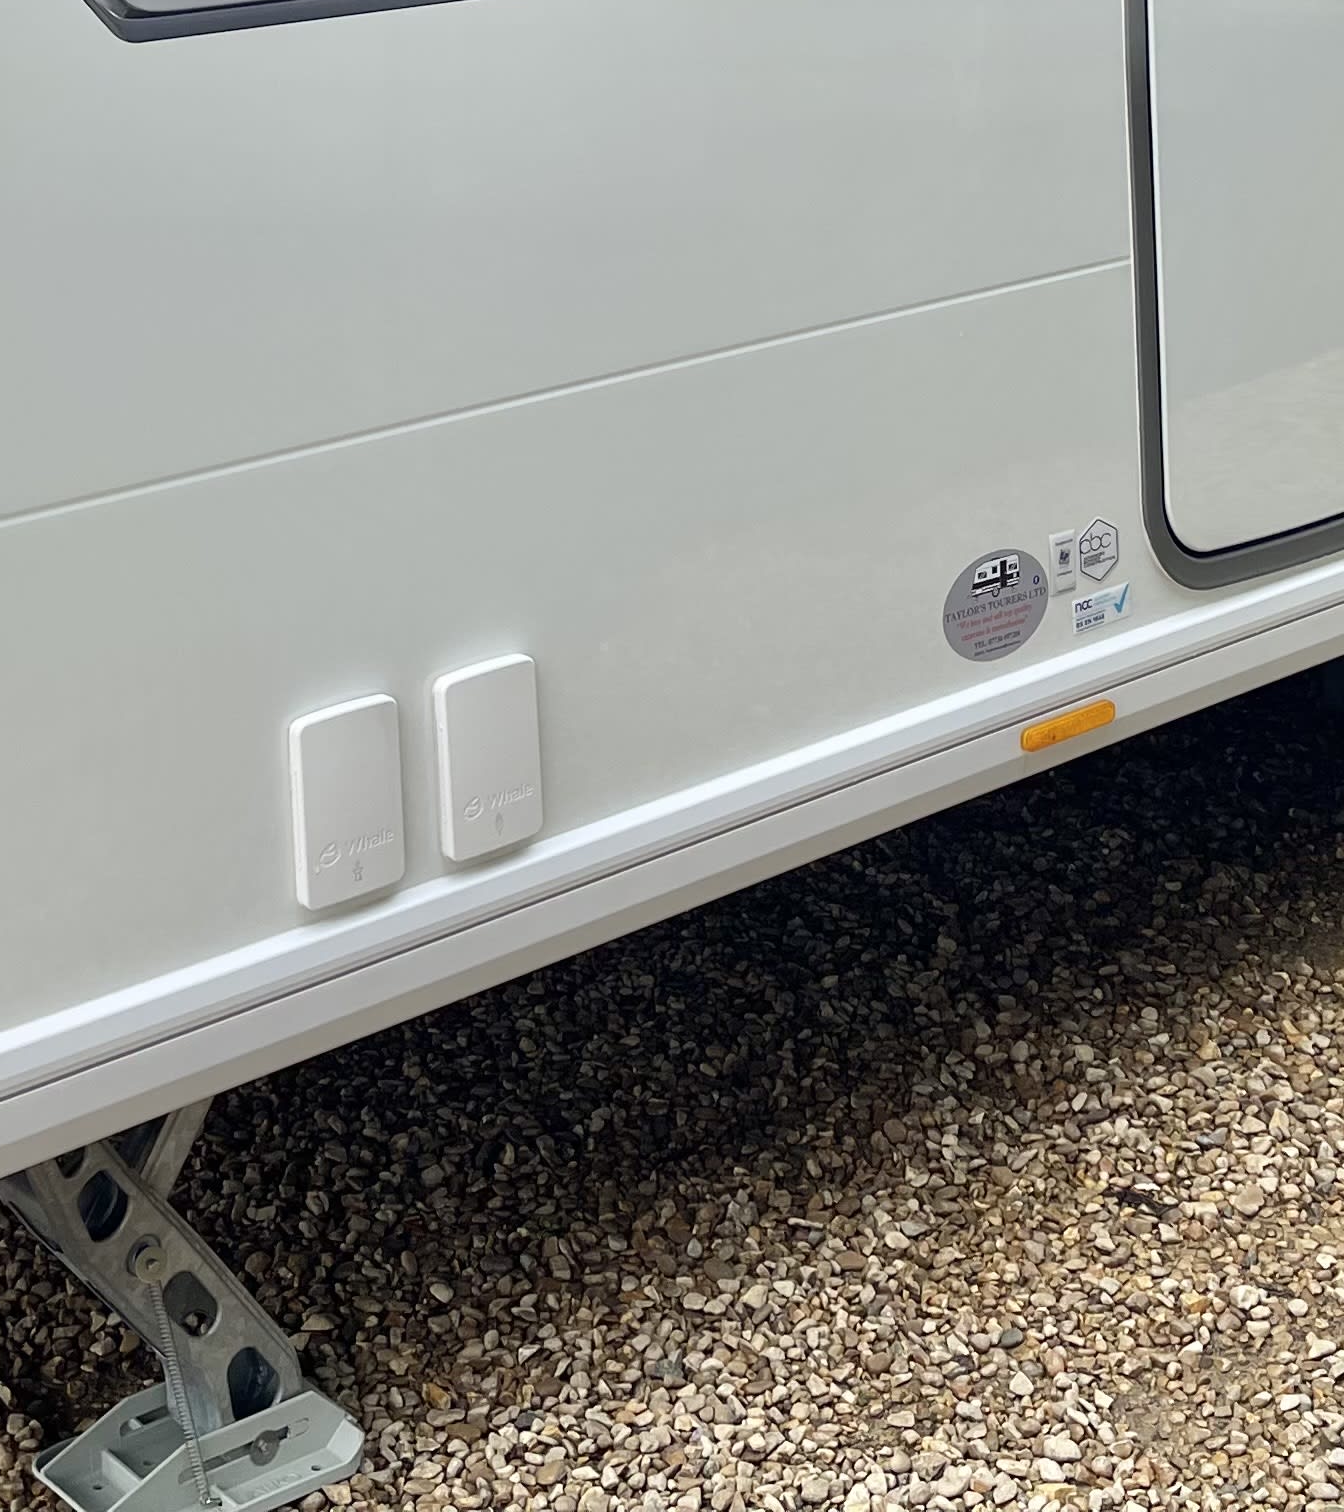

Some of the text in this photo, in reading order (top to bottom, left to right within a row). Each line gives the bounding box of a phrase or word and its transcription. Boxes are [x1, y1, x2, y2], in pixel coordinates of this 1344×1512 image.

[988, 591, 1028, 611] TOURERS
[1028, 586, 1047, 601] LTD
[488, 783, 536, 810] Whale
[348, 828, 395, 857] Whale
